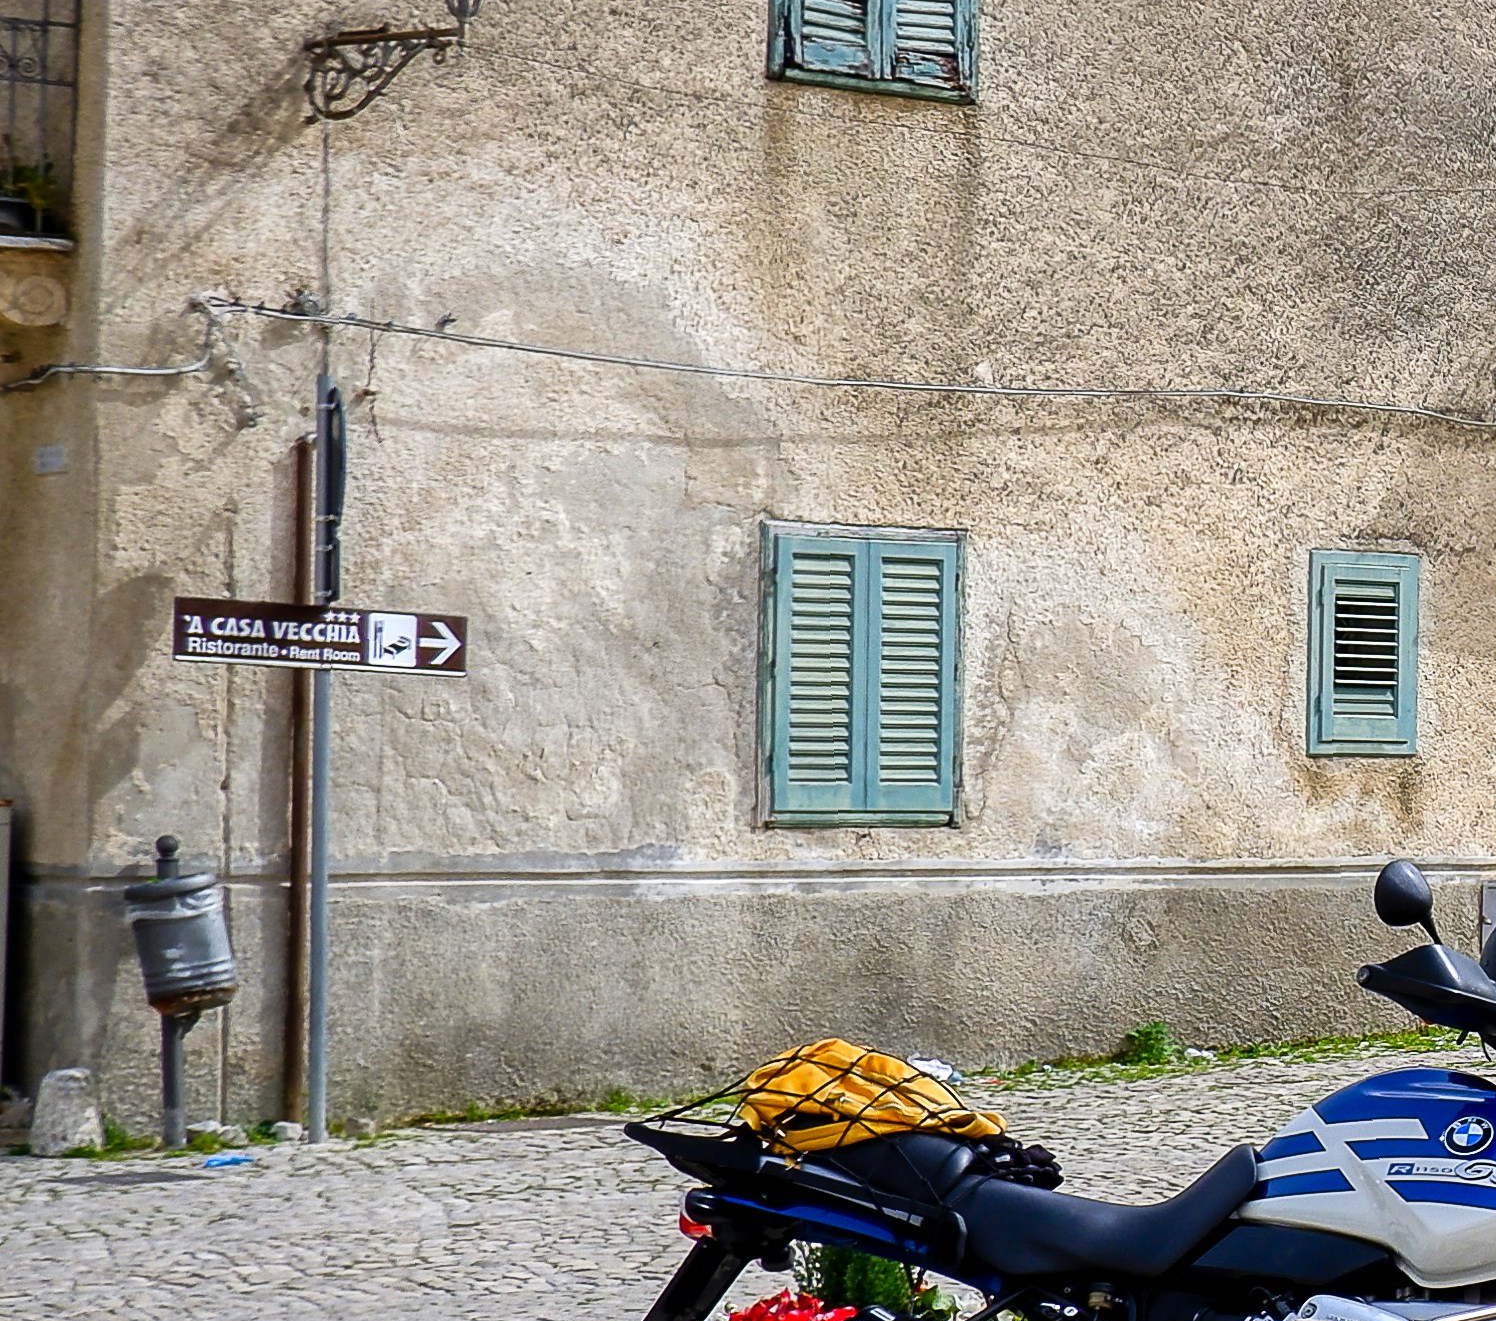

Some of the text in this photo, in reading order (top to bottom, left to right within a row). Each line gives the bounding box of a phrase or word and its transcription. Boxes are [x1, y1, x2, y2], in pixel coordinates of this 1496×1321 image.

[210, 617, 266, 638] CASA
[272, 621, 361, 644] VECCHIA
[187, 636, 361, 663] Ristorante Rent Room
